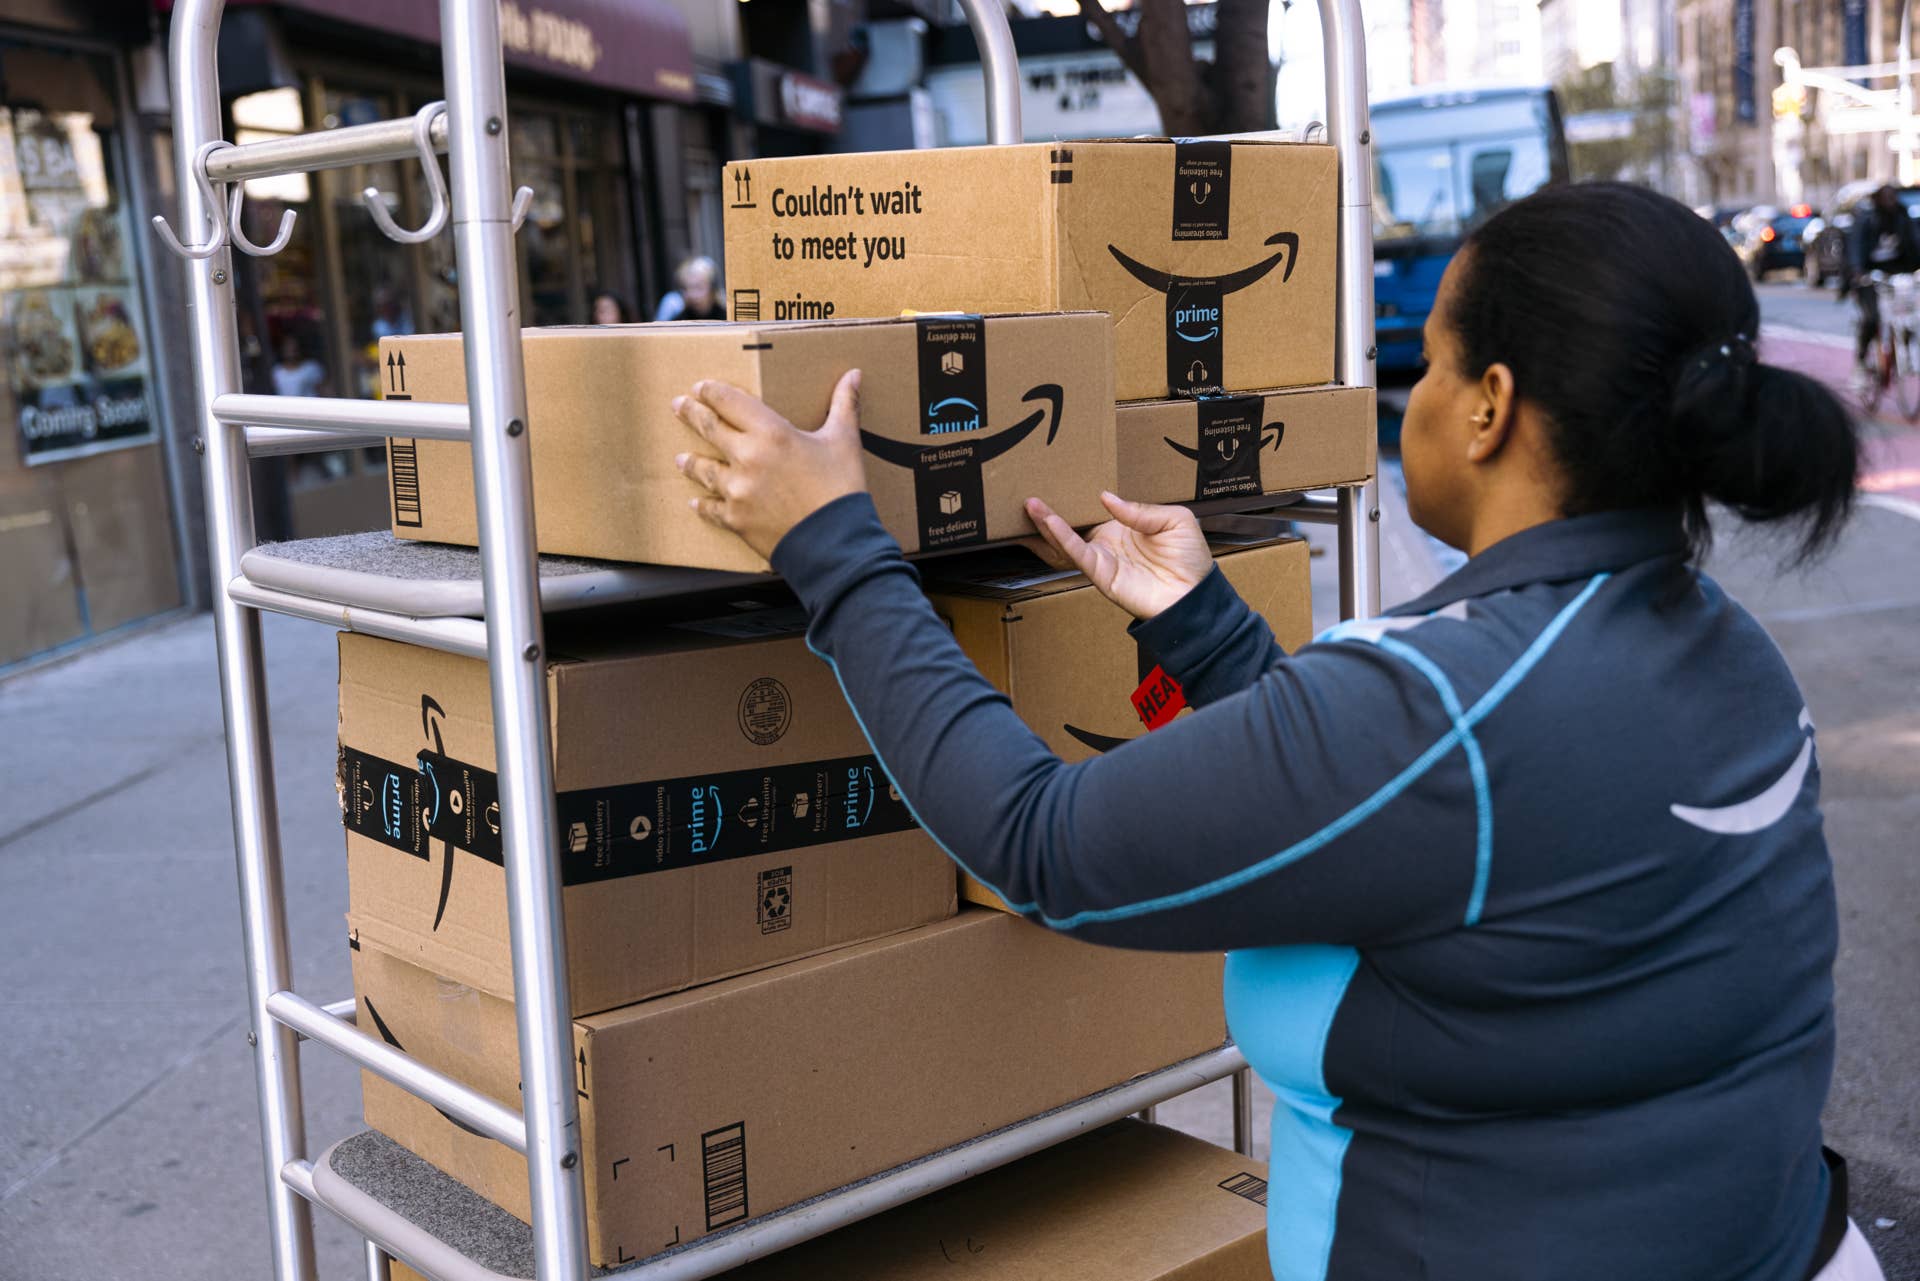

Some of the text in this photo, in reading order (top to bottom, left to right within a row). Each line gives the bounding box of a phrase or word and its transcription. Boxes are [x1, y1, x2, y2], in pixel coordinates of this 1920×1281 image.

[1179, 166, 1223, 178] free listening
[772, 181, 922, 217] Couldn't wait
[1174, 229, 1223, 239] video streaming
[773, 231, 906, 269] to meet you
[774, 293, 835, 320] prime
[1175, 304, 1219, 328] prime
[926, 332, 959, 344] delivery
[21, 396, 147, 438] Coming Soon
[1204, 424, 1251, 437] free listening
[921, 446, 974, 463] free listening
[1203, 482, 1257, 496] video streaming
[928, 519, 978, 536] free delivery
[1138, 674, 1177, 722] HEA
[389, 773, 403, 840] prime
[463, 769, 472, 845] video streaming
[843, 767, 860, 829] prime
[688, 786, 708, 853] prime
[656, 836, 664, 864] video
